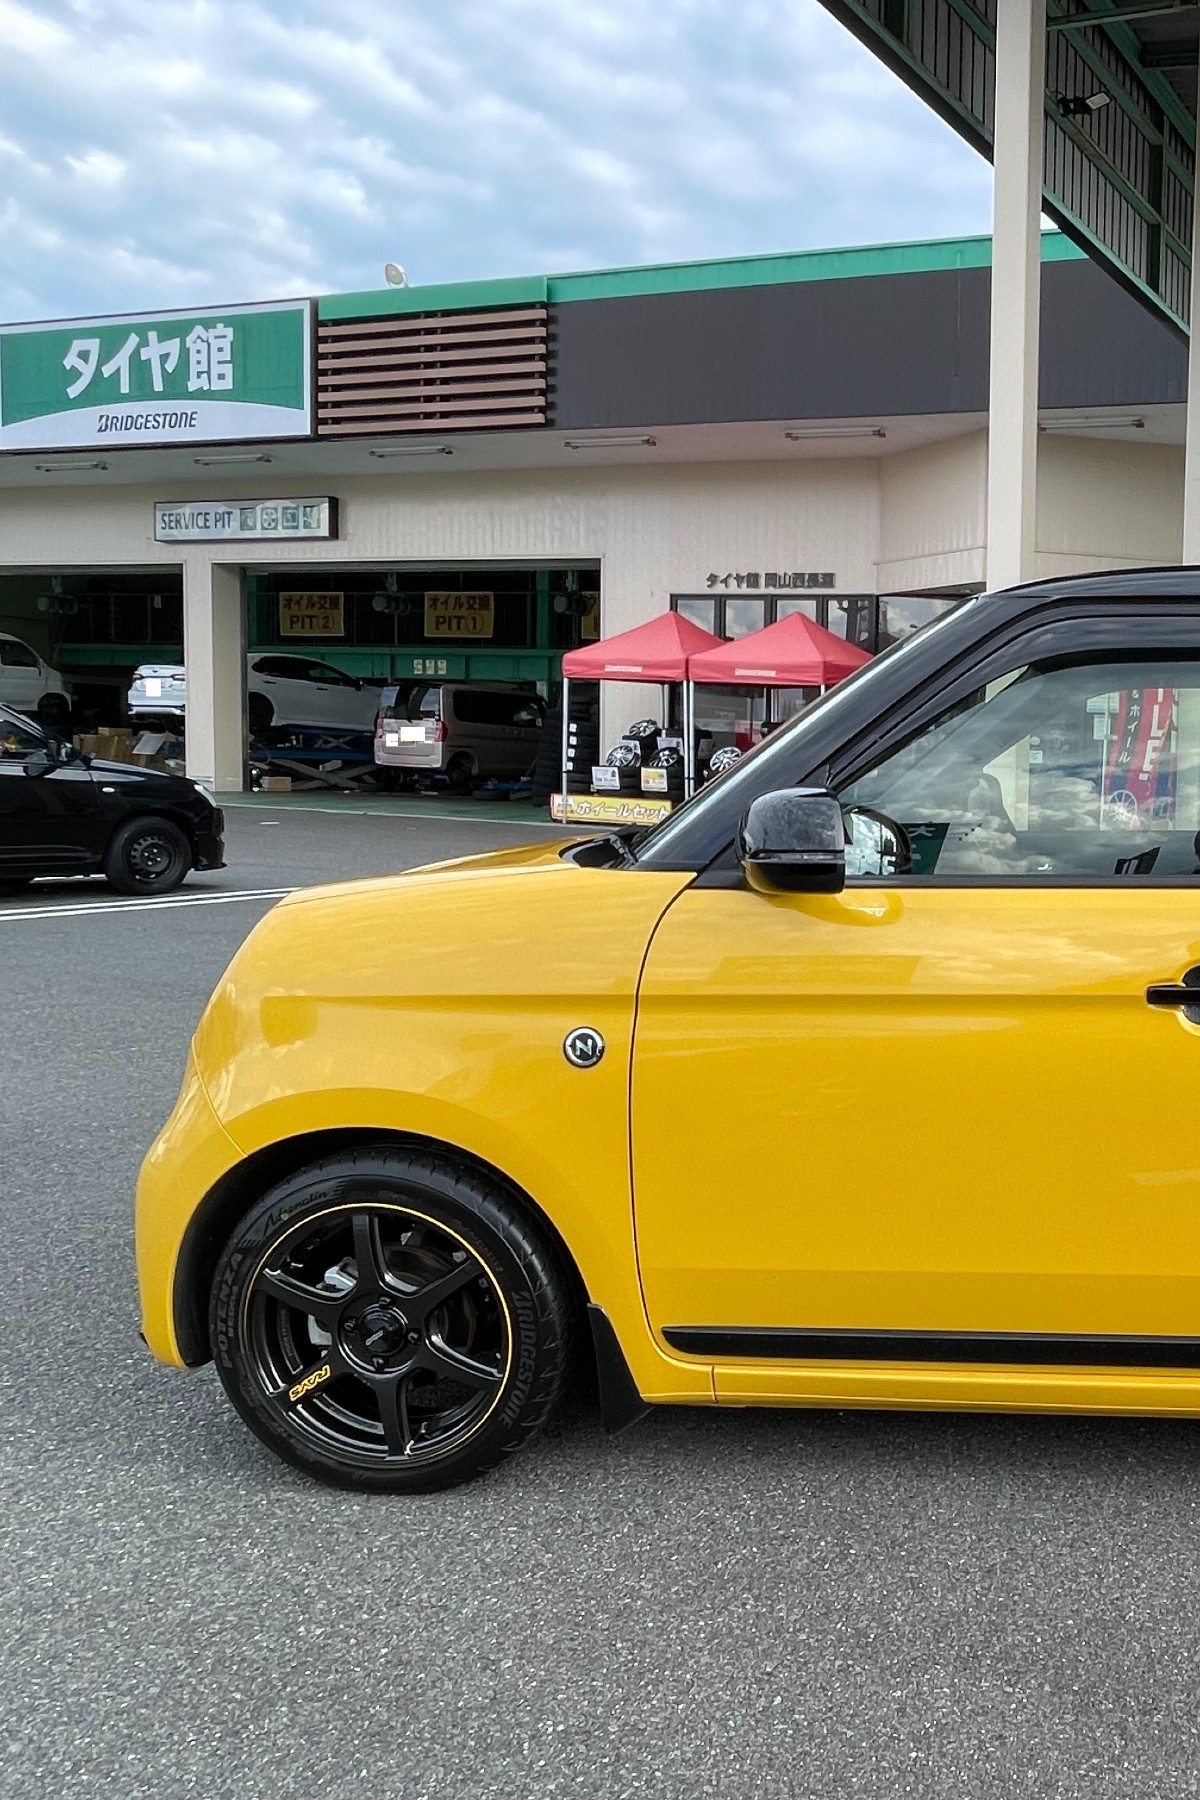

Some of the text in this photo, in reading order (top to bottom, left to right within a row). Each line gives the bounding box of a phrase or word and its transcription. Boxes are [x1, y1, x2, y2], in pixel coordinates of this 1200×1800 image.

[63, 323, 234, 399] タイヤ館
[97, 411, 198, 433] BRIDGESTONE
[160, 510, 233, 530] SERVICE PIT
[289, 1364, 331, 1401] RAYS
